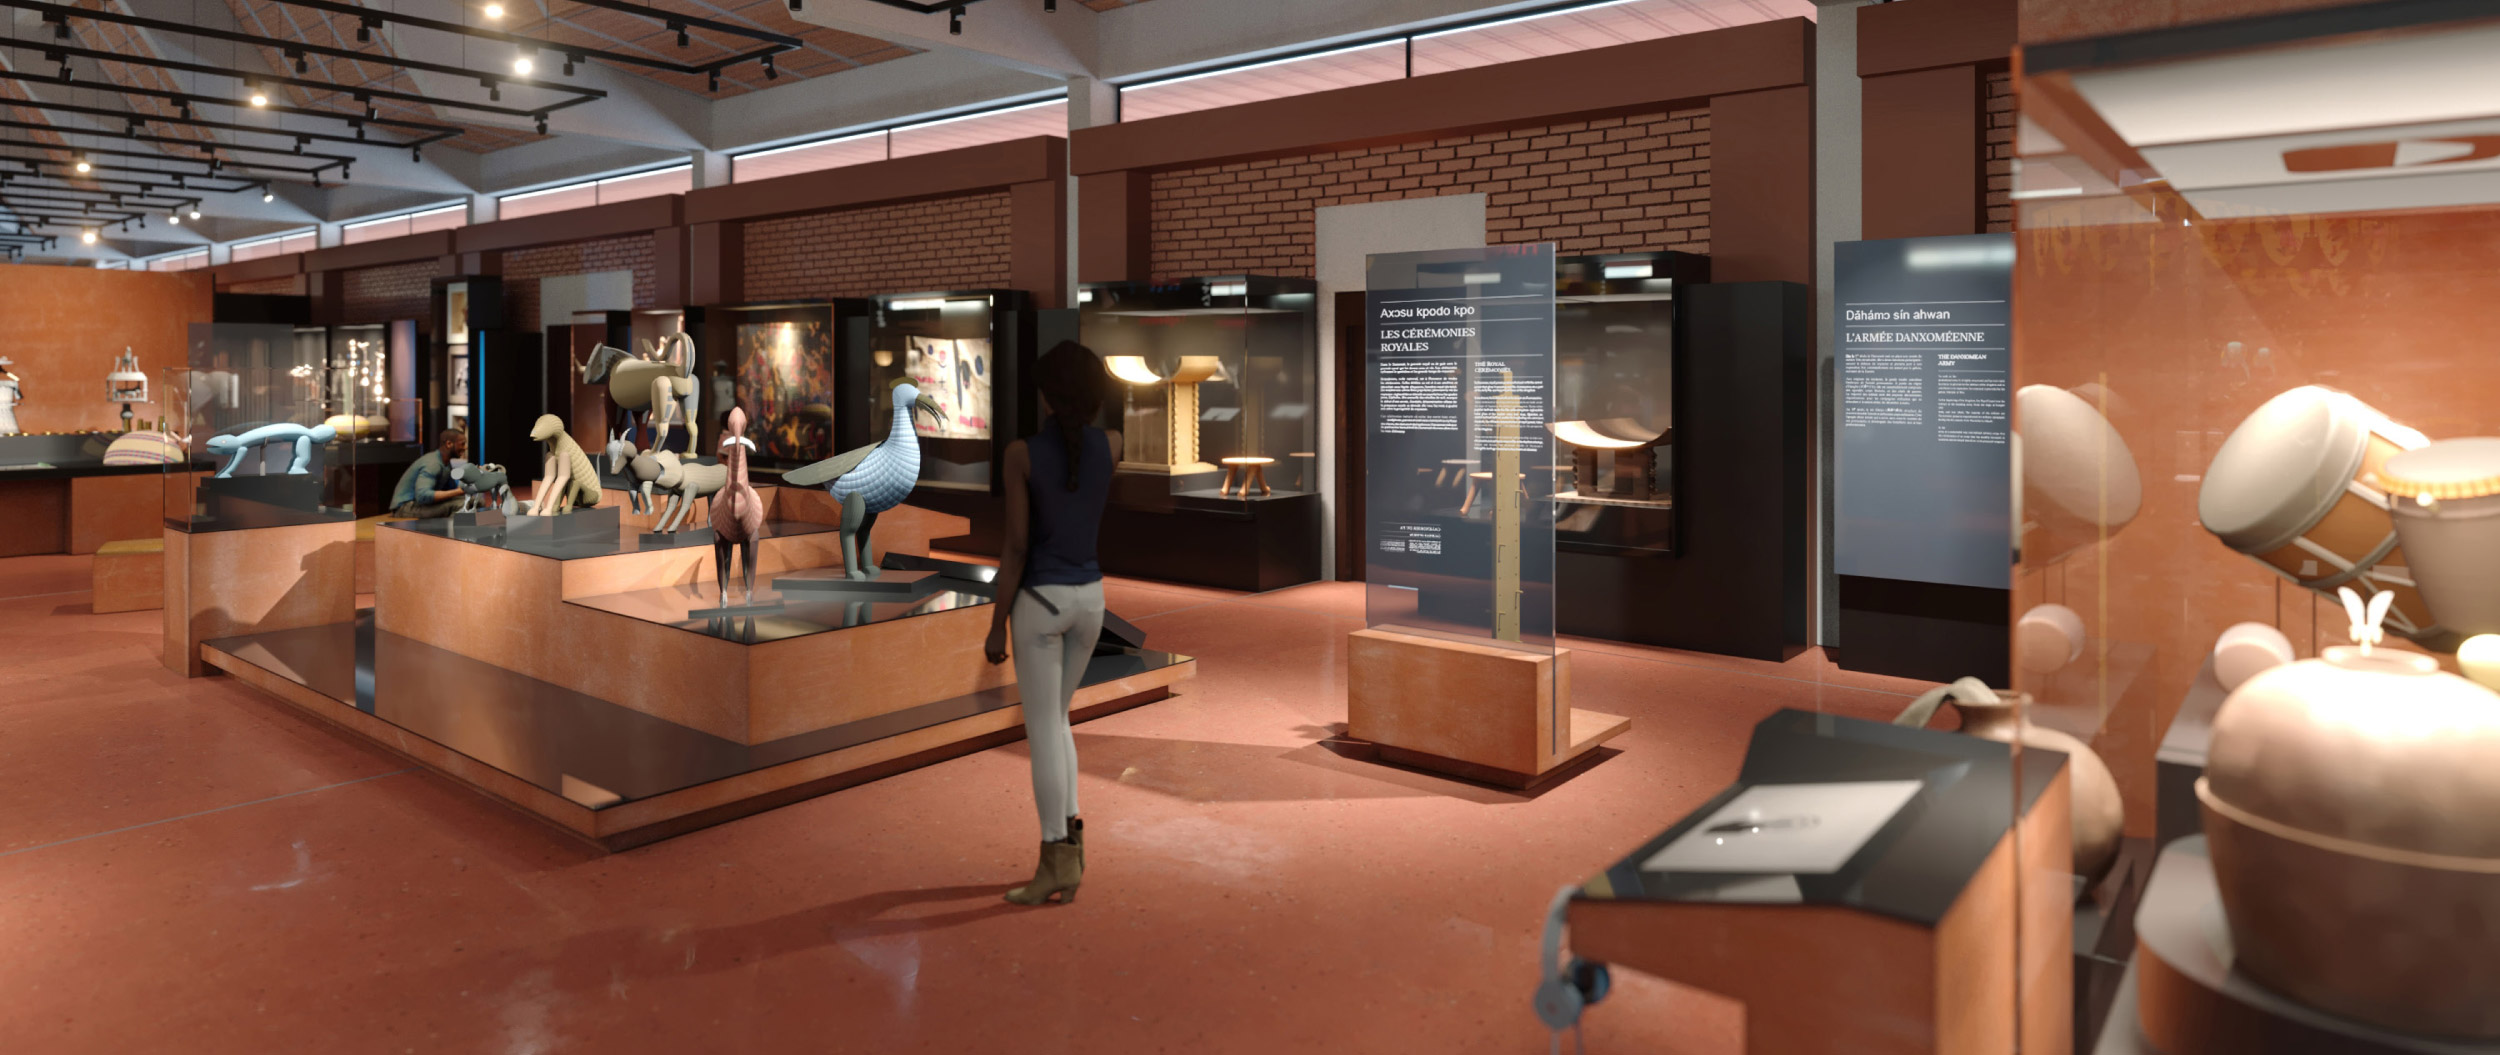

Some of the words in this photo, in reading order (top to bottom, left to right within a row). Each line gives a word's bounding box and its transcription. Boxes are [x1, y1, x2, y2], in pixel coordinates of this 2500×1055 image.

[1416, 306, 1450, 319] kpodo
[1453, 306, 1475, 318] kpo
[1913, 308, 1950, 320] ahwan
[1381, 330, 1400, 339] LES
[1402, 328, 1476, 339] CÉRÉMONIES
[1895, 331, 1985, 342] DANXOMÉENNE
[1381, 342, 1429, 352] ROYALES
